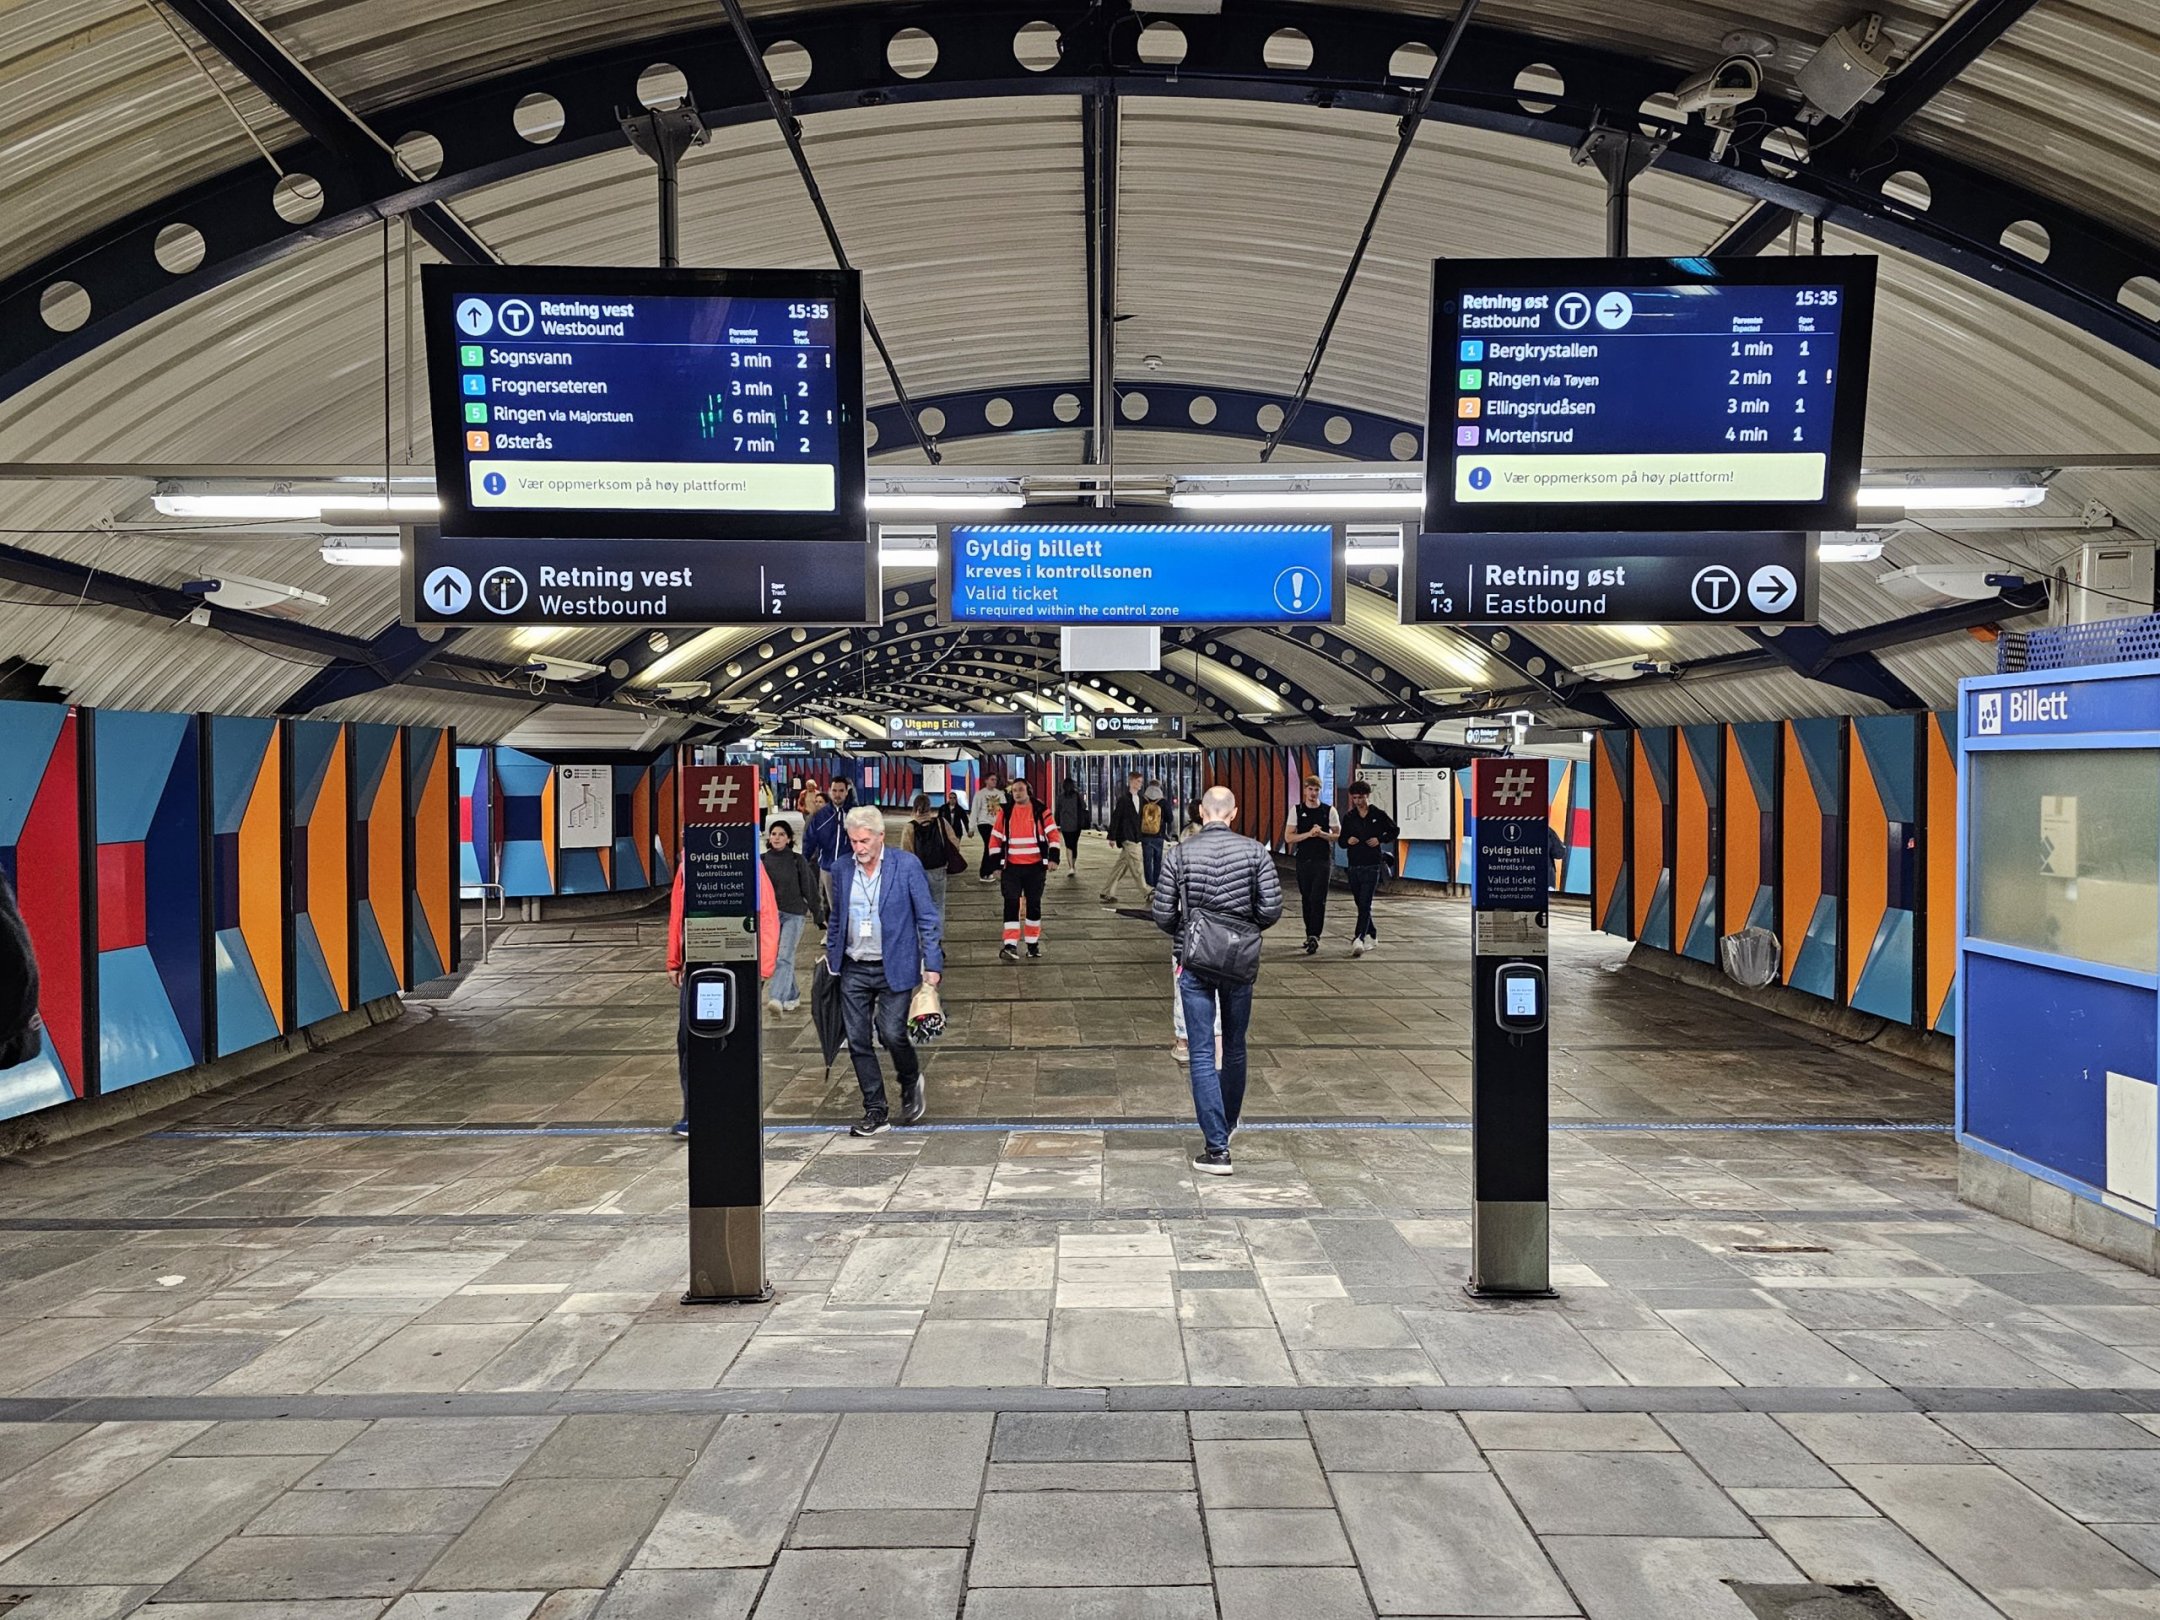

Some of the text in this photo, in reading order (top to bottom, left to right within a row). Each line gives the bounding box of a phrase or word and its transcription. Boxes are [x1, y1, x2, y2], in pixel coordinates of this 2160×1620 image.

[1463, 294, 1549, 312] Retning øst
[1796, 290, 1838, 306] 15:35
[540, 301, 635, 319] Retning vest
[788, 304, 829, 319] 15:35
[541, 320, 624, 336] Westbound
[1462, 314, 1541, 328] Eastbound
[468, 350, 476, 362] 5
[490, 349, 573, 367] Sognsvann
[730, 352, 740, 368] 3
[744, 352, 772, 368] min
[797, 353, 808, 368] 2
[1467, 340, 1810, 361] 1 Bergkrystallen 1 min 1
[470, 377, 809, 397] 1 Frognerseteren 3 min 2
[1466, 374, 1474, 385] 5
[1488, 372, 1541, 389] Ringen
[1543, 375, 1561, 386] via
[1564, 374, 1599, 388] Tøyen
[1728, 369, 1740, 385] 2
[1743, 369, 1772, 385] min
[1797, 369, 1808, 385] 1
[472, 408, 480, 419] 5
[493, 406, 547, 424] Ringen
[549, 410, 567, 422] via
[569, 410, 634, 424] Majorstuen
[732, 409, 743, 424] 6
[747, 409, 775, 424] min
[799, 410, 809, 425] 2
[1465, 398, 1806, 418] 2 Ellingsrudåsen 3 min 1
[474, 432, 810, 453] 2 Østerås 7 min 2
[1464, 426, 1804, 443] 3 Mortensrud 4 min 1
[518, 477, 747, 494] Vær oppmerksom på høy plattform!
[1504, 470, 1734, 486] Vær oppmerksom på høy plattform!
[965, 539, 1102, 561] Gyldig billett
[539, 566, 692, 591] Retning vest
[965, 565, 1153, 579] kreves i kontrollsonen
[1486, 565, 1625, 591] Retning øst
[965, 586, 1058, 600] Valid ticket
[539, 596, 668, 616] Westbound
[772, 598, 782, 614] 2
[965, 605, 1180, 619] is required within the control zone
[1486, 594, 1607, 615] Eastbound
[2010, 689, 2068, 722] Billett
[905, 719, 960, 730] Utgang Exit
[690, 852, 749, 863] Gyldig billett
[1482, 846, 1542, 857] Gyldig billett
[696, 882, 744, 890] Valid ticket
[1487, 876, 1536, 884] Valid ticket
